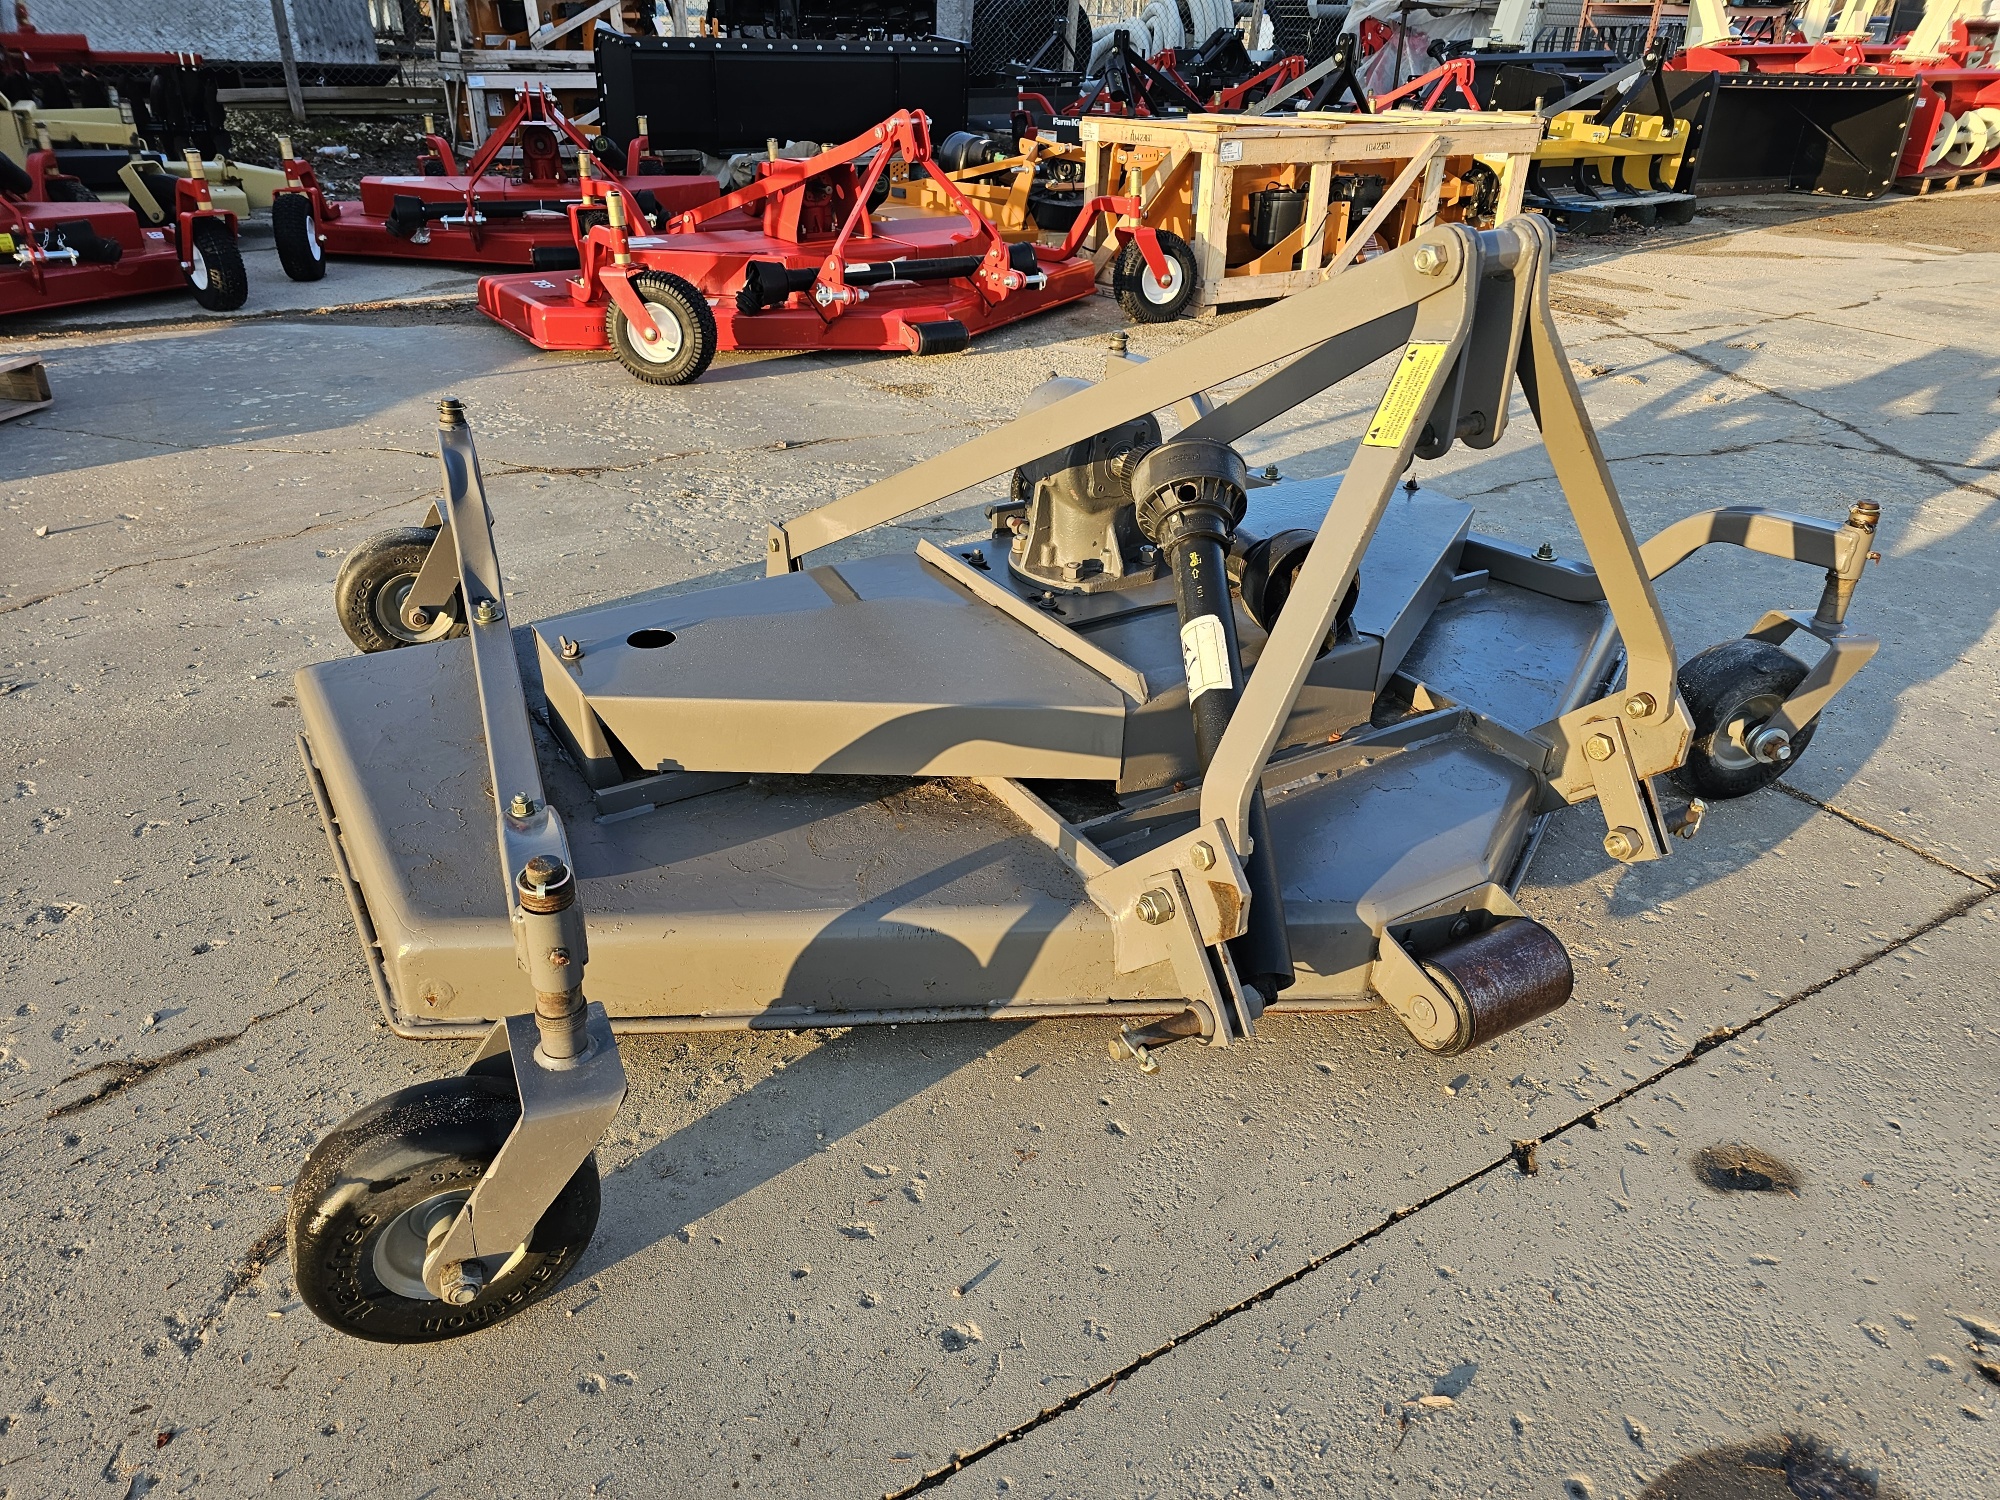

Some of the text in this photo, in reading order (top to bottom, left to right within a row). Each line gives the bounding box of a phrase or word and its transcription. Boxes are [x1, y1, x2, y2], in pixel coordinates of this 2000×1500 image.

[1052, 117, 1080, 127] Farm Ki
[1382, 375, 1404, 411] WARNING
[1394, 389, 1405, 406] SHAFT
[1403, 366, 1416, 388] LENGTH
[393, 554, 424, 566] 9x3.
[418, 1246, 568, 1333] marathon
